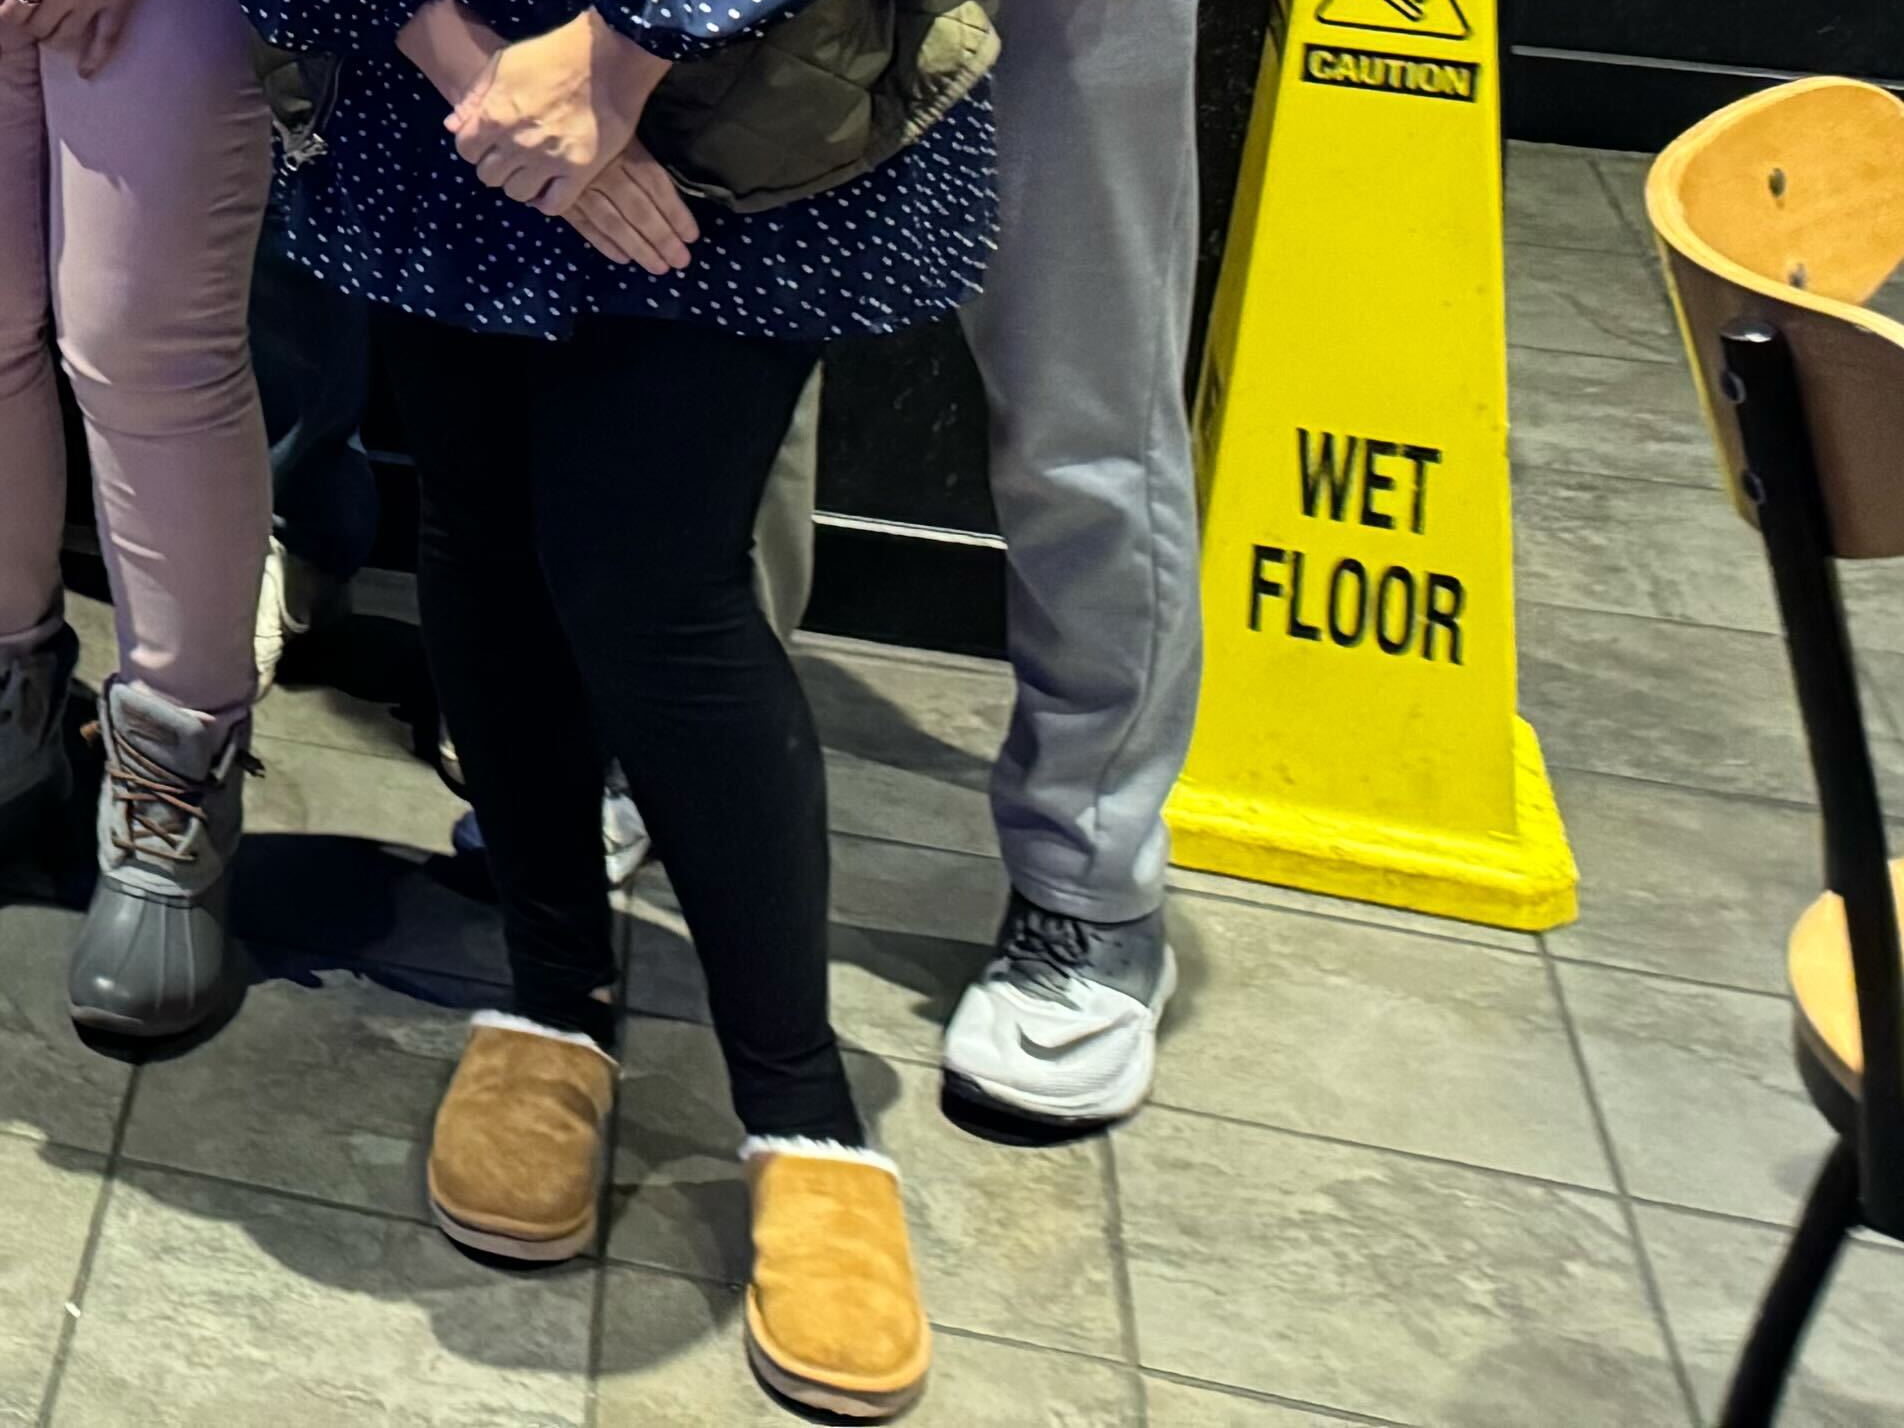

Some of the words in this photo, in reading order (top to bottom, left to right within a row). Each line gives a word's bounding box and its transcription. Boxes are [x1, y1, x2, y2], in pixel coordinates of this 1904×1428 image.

[1308, 48, 1474, 98] CAUTION
[1295, 426, 1443, 532] WET
[1248, 546, 1466, 667] FLOOR
